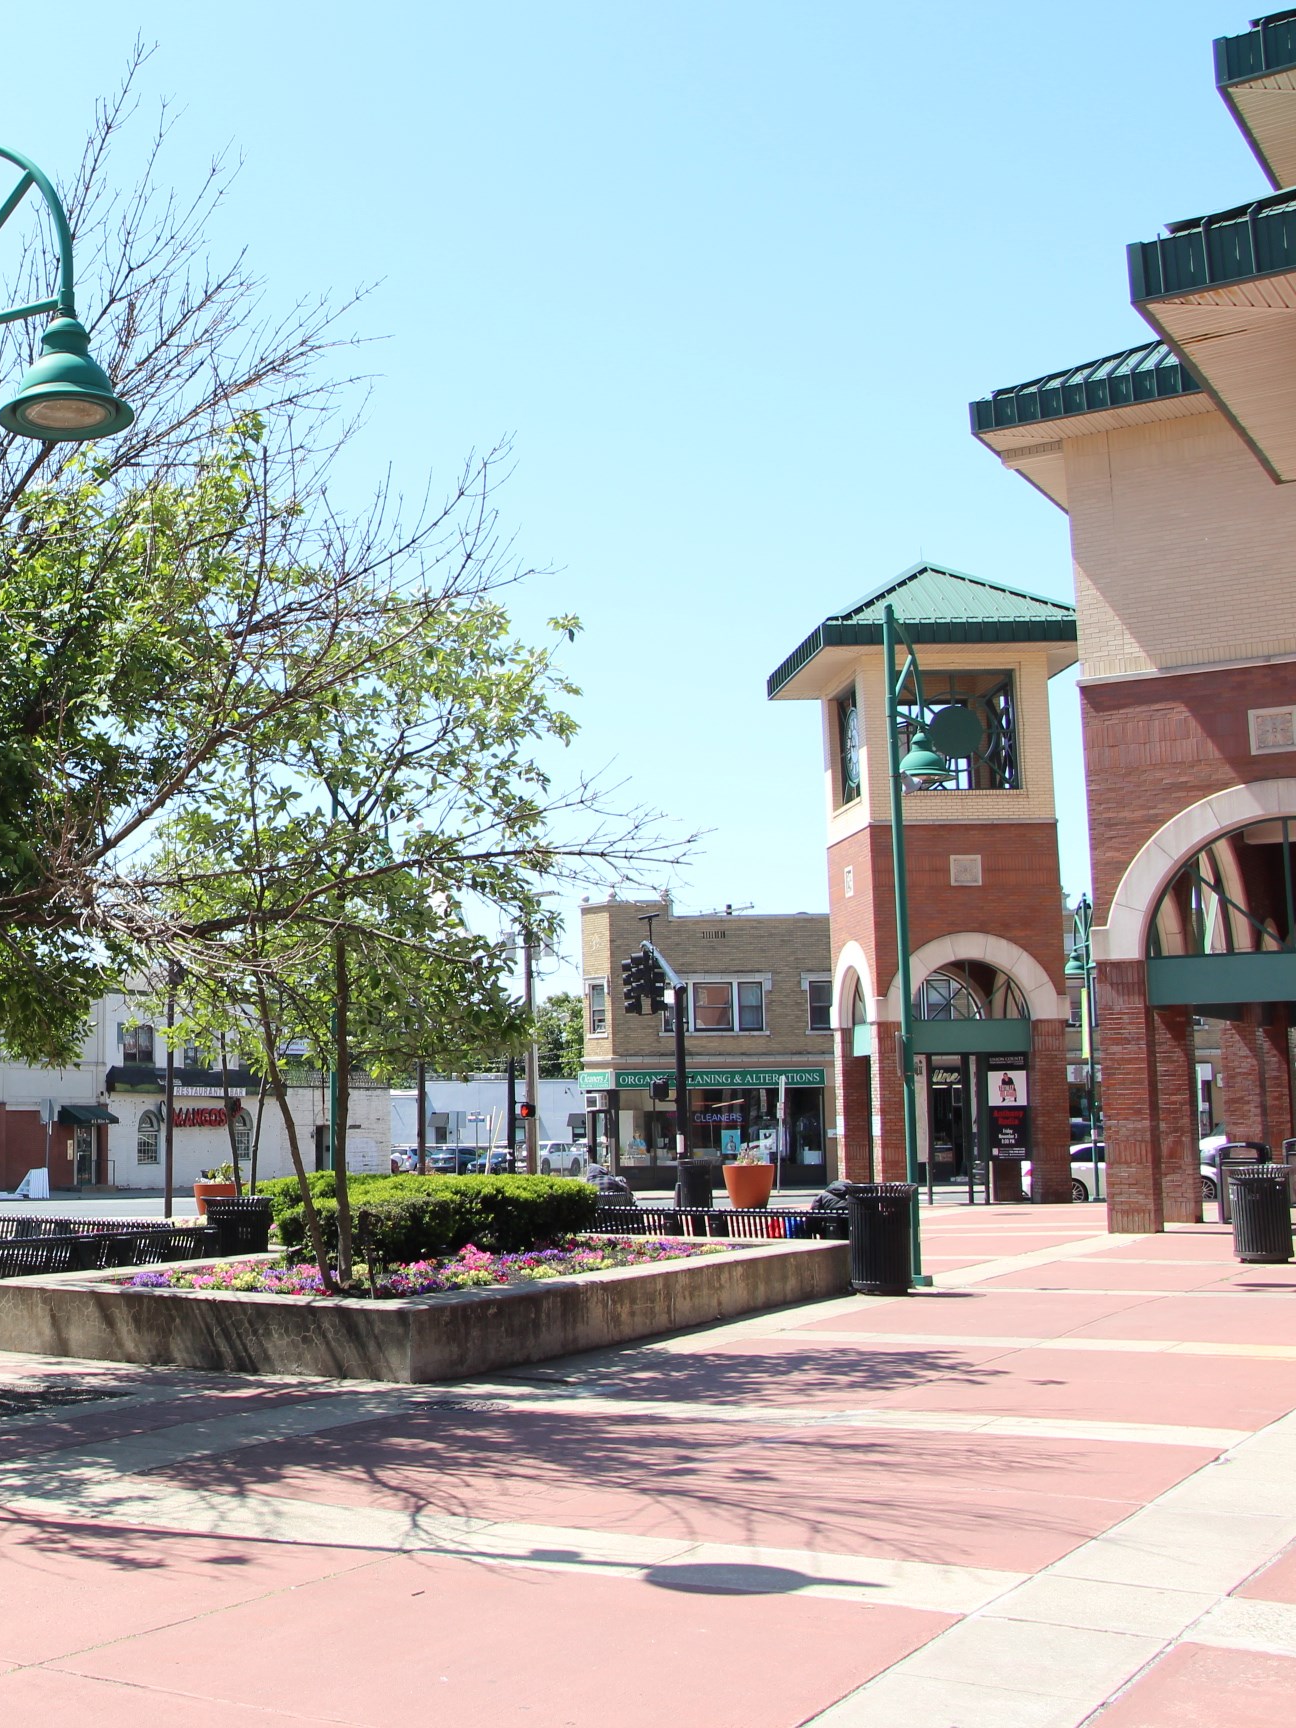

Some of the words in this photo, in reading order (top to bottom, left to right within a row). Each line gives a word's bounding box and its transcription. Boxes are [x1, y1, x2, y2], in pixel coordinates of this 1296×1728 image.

[619, 1074, 671, 1085] ORGAN
[733, 1074, 743, 1083] &
[175, 1086, 223, 1097] RESTAURANT
[229, 1089, 245, 1097] BAR
[694, 1113, 743, 1122] CLEANERS
